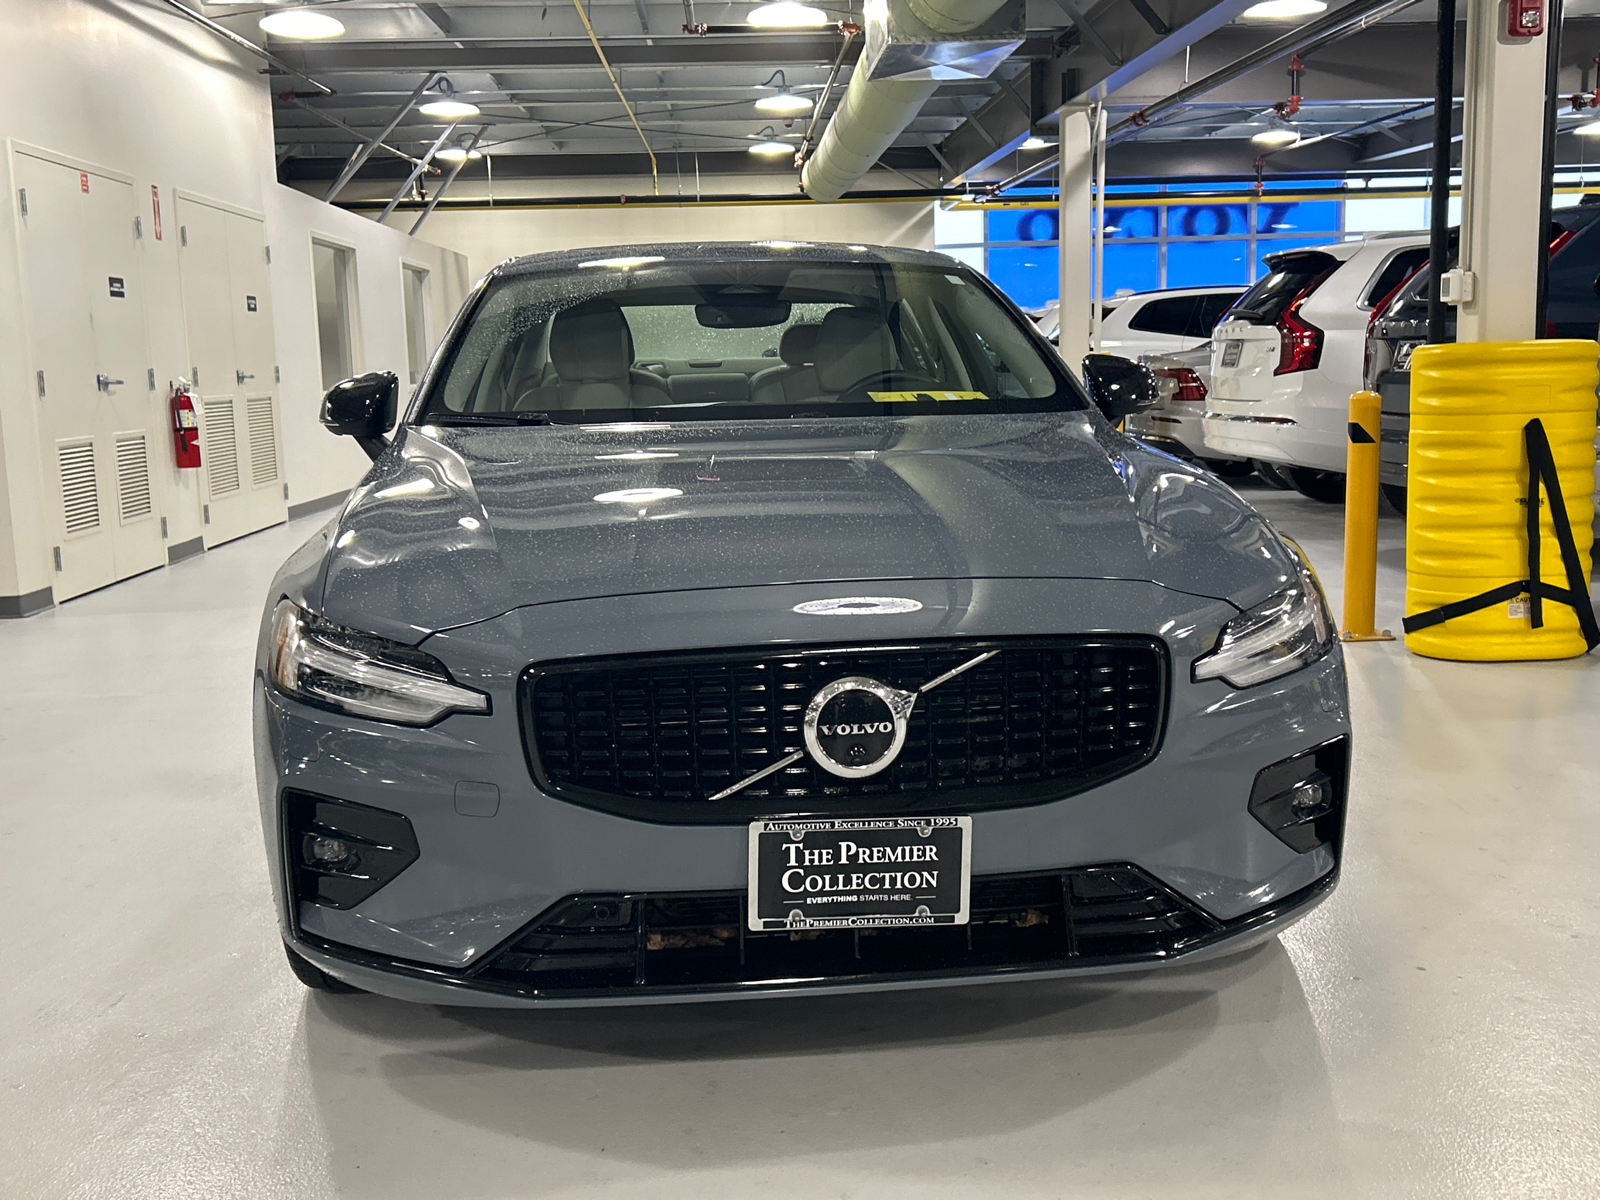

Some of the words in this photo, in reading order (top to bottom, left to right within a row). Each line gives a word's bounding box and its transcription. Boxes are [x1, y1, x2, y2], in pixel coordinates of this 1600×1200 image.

[819, 722, 893, 736] VOLVO
[930, 817, 957, 827] 1995
[782, 842, 834, 867] THE
[838, 841, 939, 865] PREMIER
[781, 868, 939, 893] COLLECTION
[806, 895, 858, 905] EVERYTHING
[859, 894, 889, 902] STARTS
[890, 893, 913, 901] HERE.
